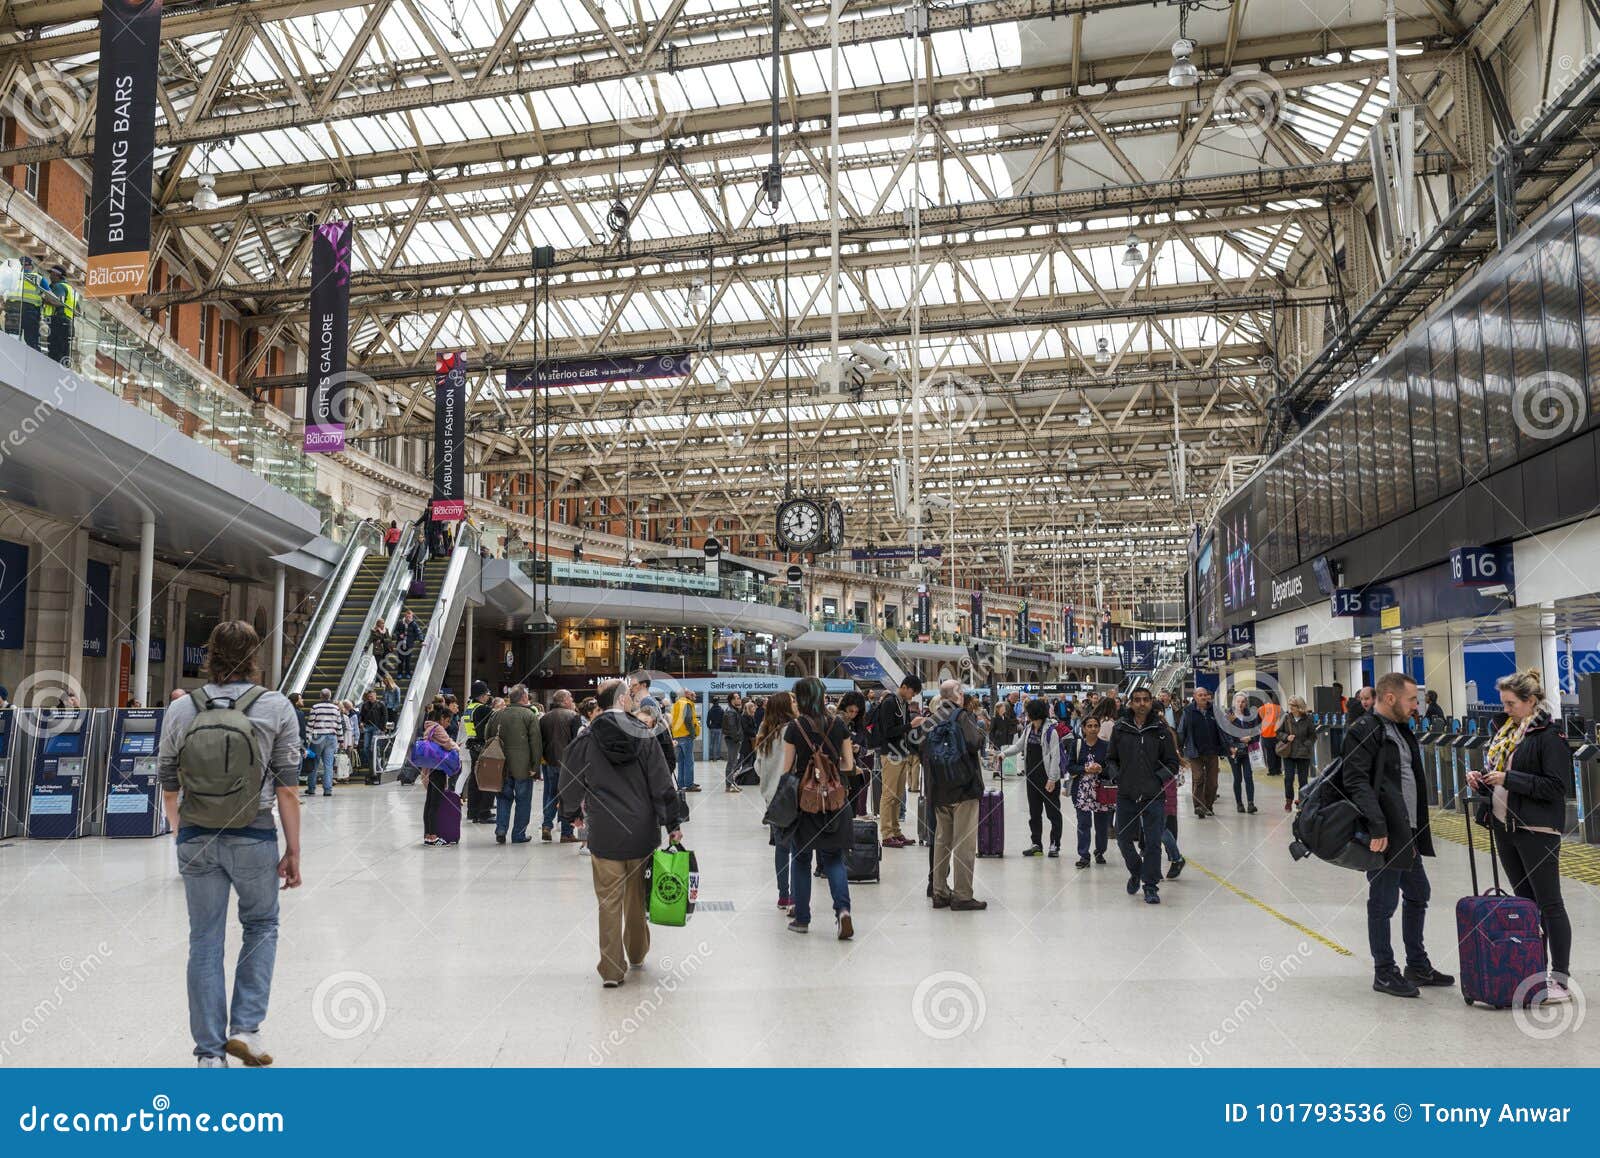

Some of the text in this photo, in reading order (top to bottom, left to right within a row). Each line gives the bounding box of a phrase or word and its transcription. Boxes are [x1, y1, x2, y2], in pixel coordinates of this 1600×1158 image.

[108, 75, 133, 242] BUZZING BARS
[88, 269, 145, 286] Balcony
[318, 312, 334, 418] GIFTS GALORE
[538, 369, 577, 381] Waterloo
[580, 367, 598, 378] East
[306, 433, 343, 445] Balcony
[443, 388, 455, 496] FABULOUS FASHION
[433, 505, 463, 517] Balcony
[1451, 554, 1462, 579] 16
[1466, 553, 1497, 577] 16
[1272, 575, 1303, 607] Departures
[1341, 593, 1363, 611] 15
[1234, 628, 1250, 637] 14
[1211, 646, 1225, 654] 13
[710, 681, 779, 690] Self-service tickets
